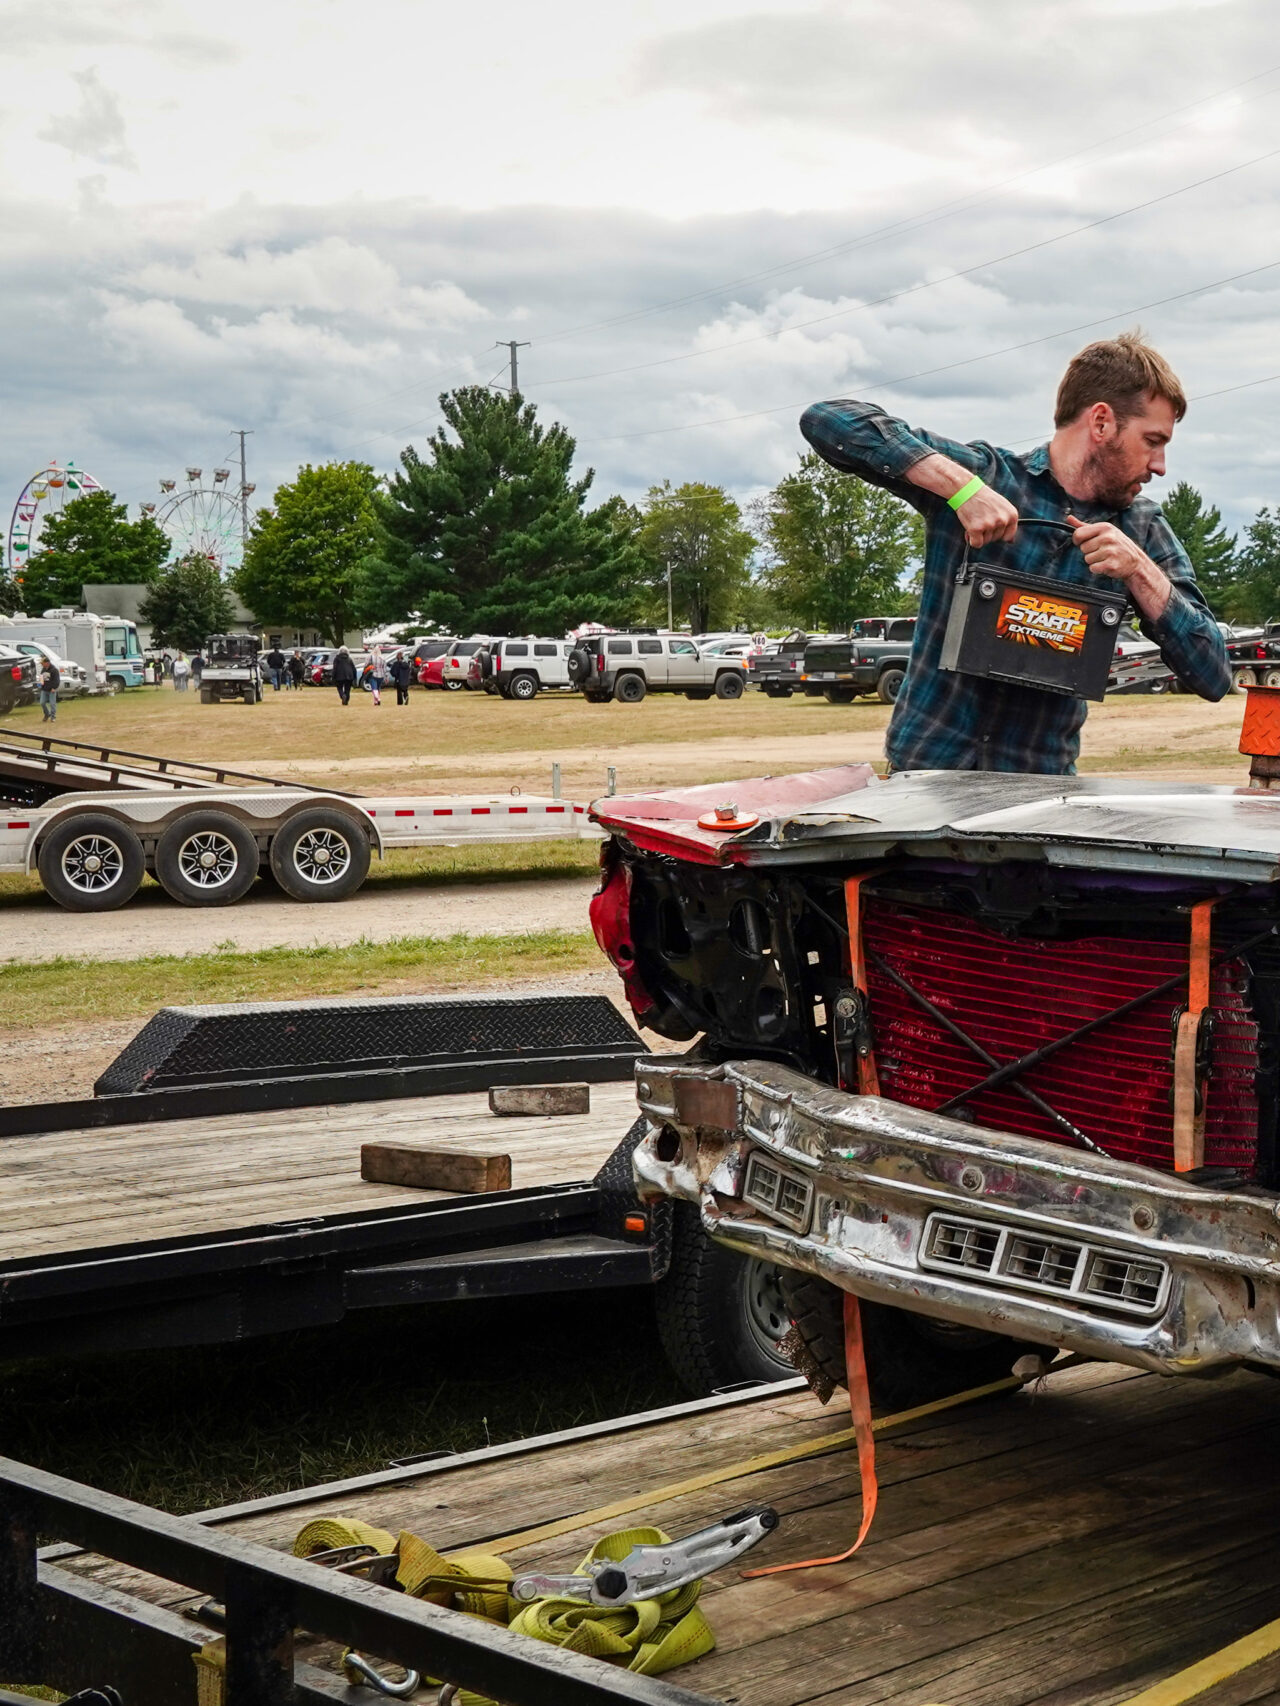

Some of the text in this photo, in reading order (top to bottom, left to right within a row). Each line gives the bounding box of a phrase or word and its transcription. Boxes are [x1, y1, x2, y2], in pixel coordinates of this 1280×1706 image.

[1005, 604, 1081, 632] START
[1018, 595, 1082, 619] SUPER
[1008, 624, 1065, 642] EXTREME
